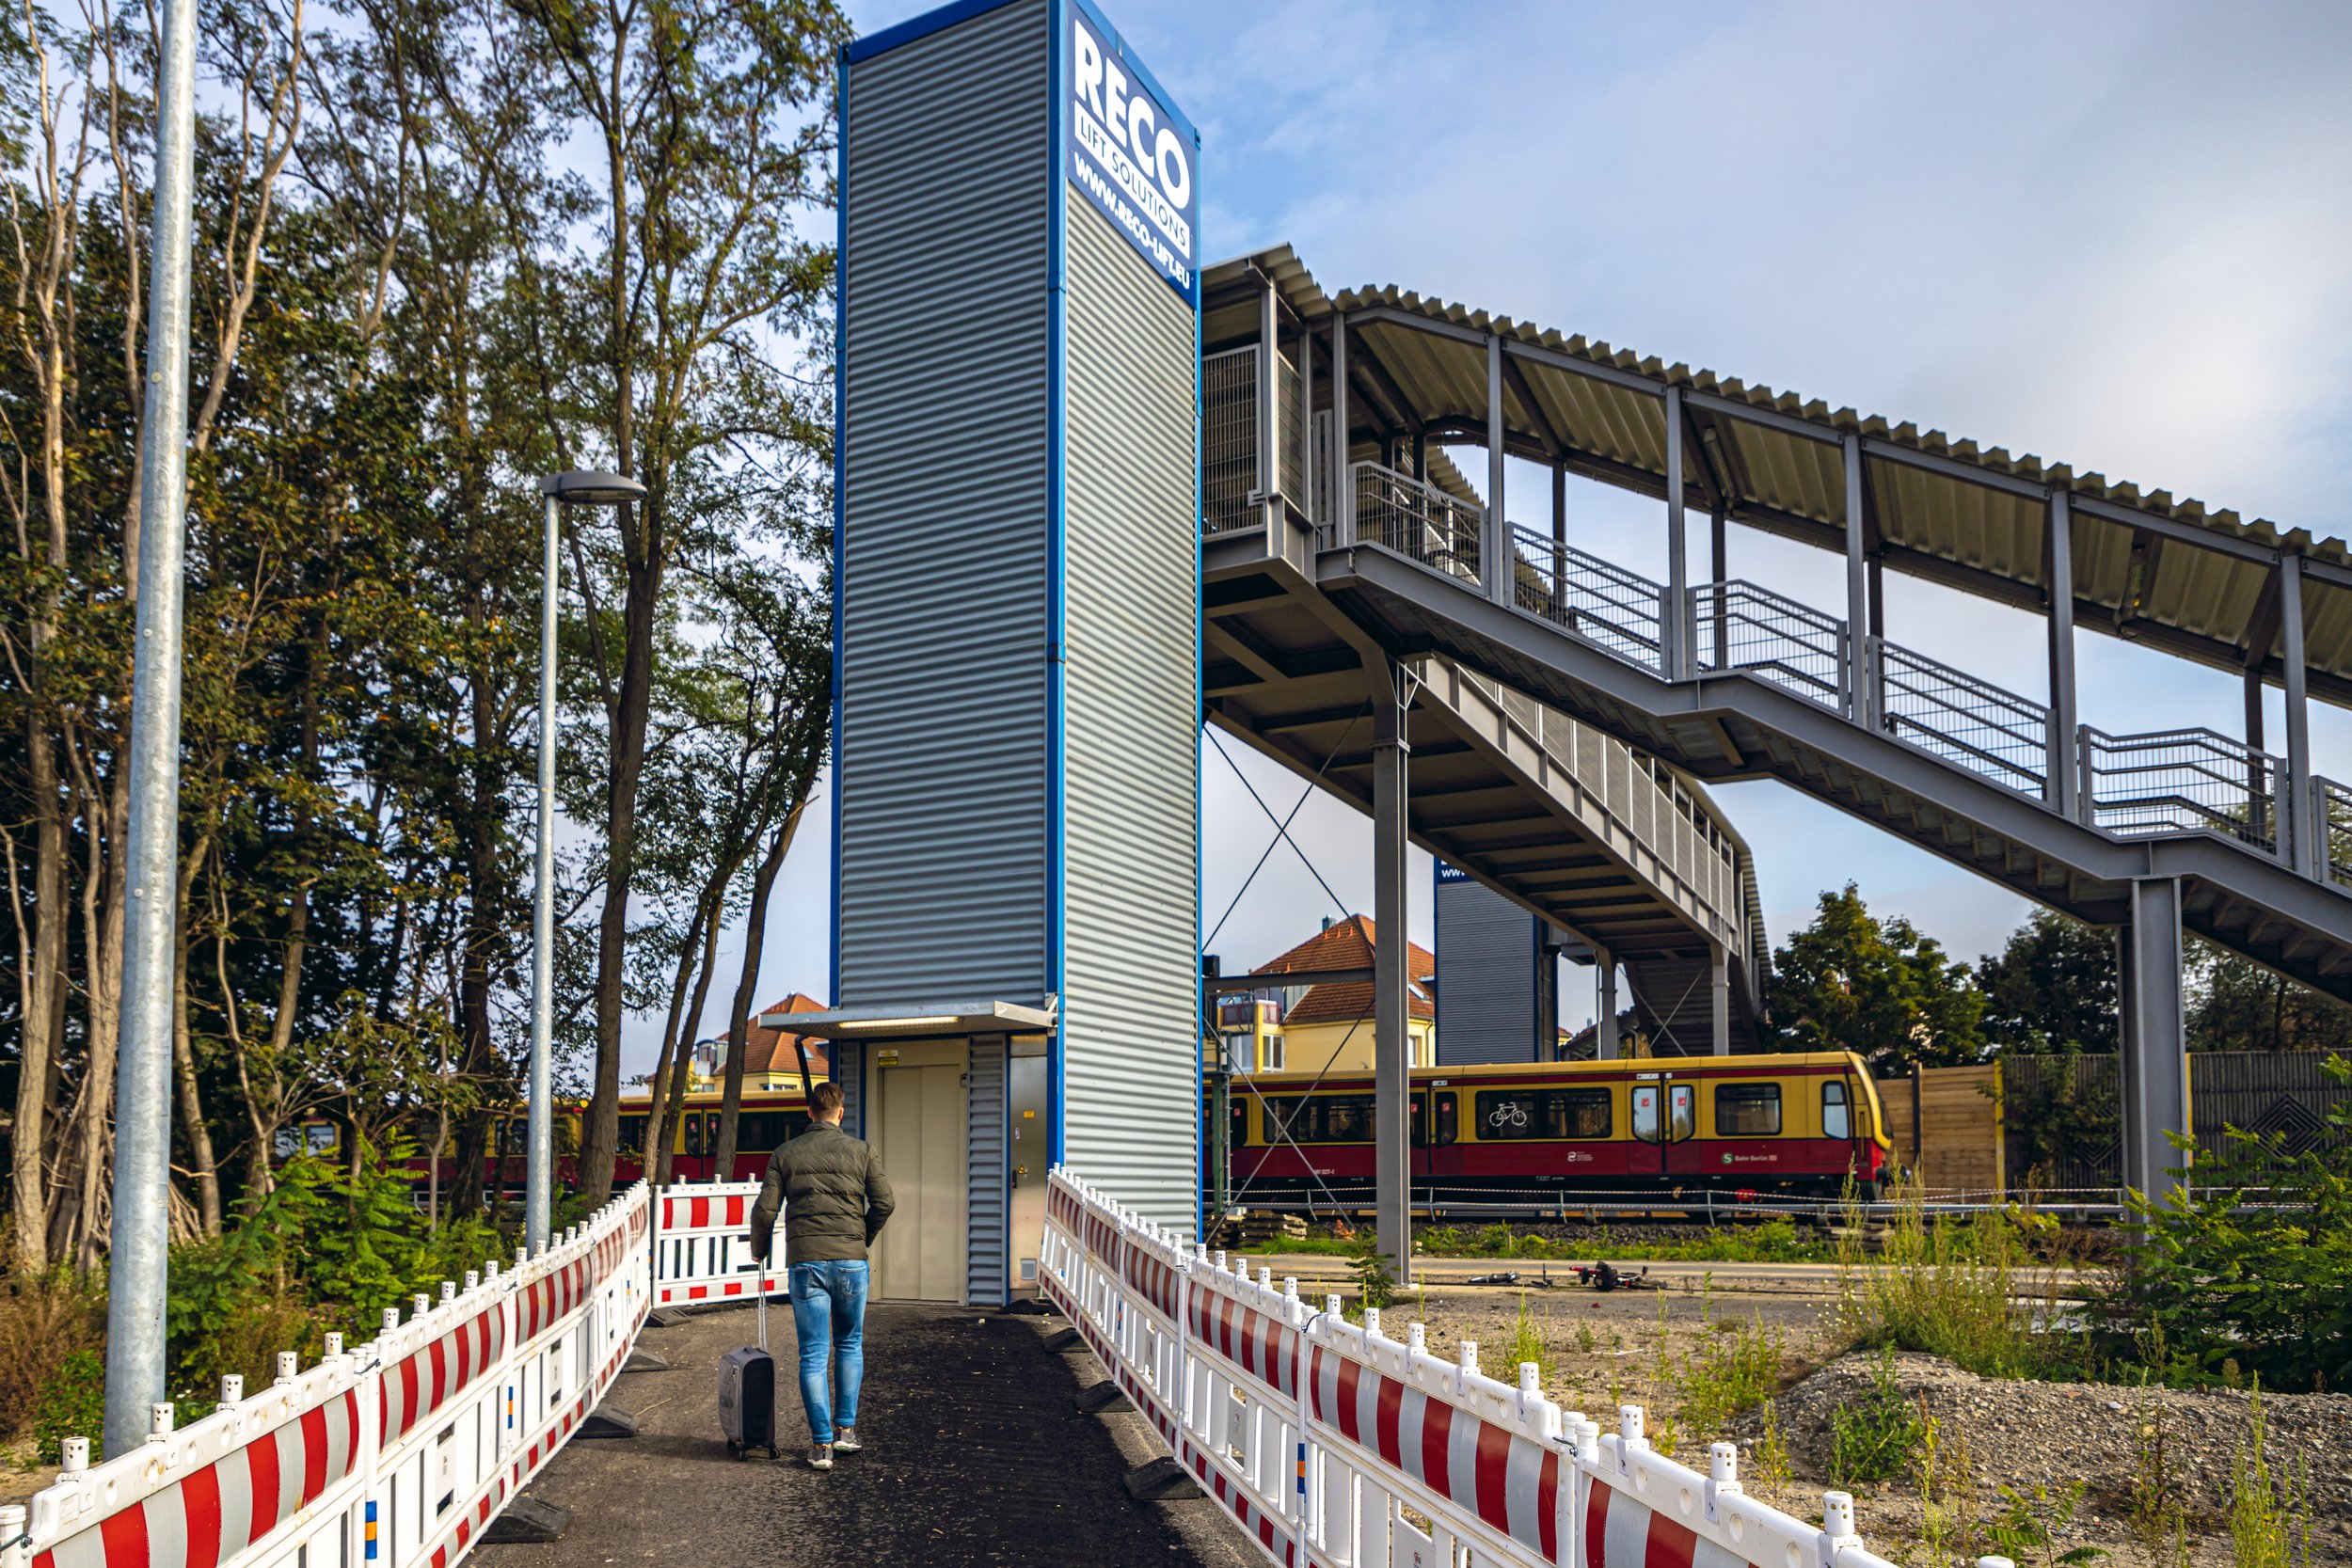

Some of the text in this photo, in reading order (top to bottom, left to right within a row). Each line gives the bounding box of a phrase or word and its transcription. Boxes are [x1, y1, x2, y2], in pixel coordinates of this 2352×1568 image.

[1074, 19, 1190, 210] RECO
[1080, 115, 1185, 247] LIFT SOLUTIONS
[1074, 150, 1190, 290] WWW.RECO-LIFT.EU
